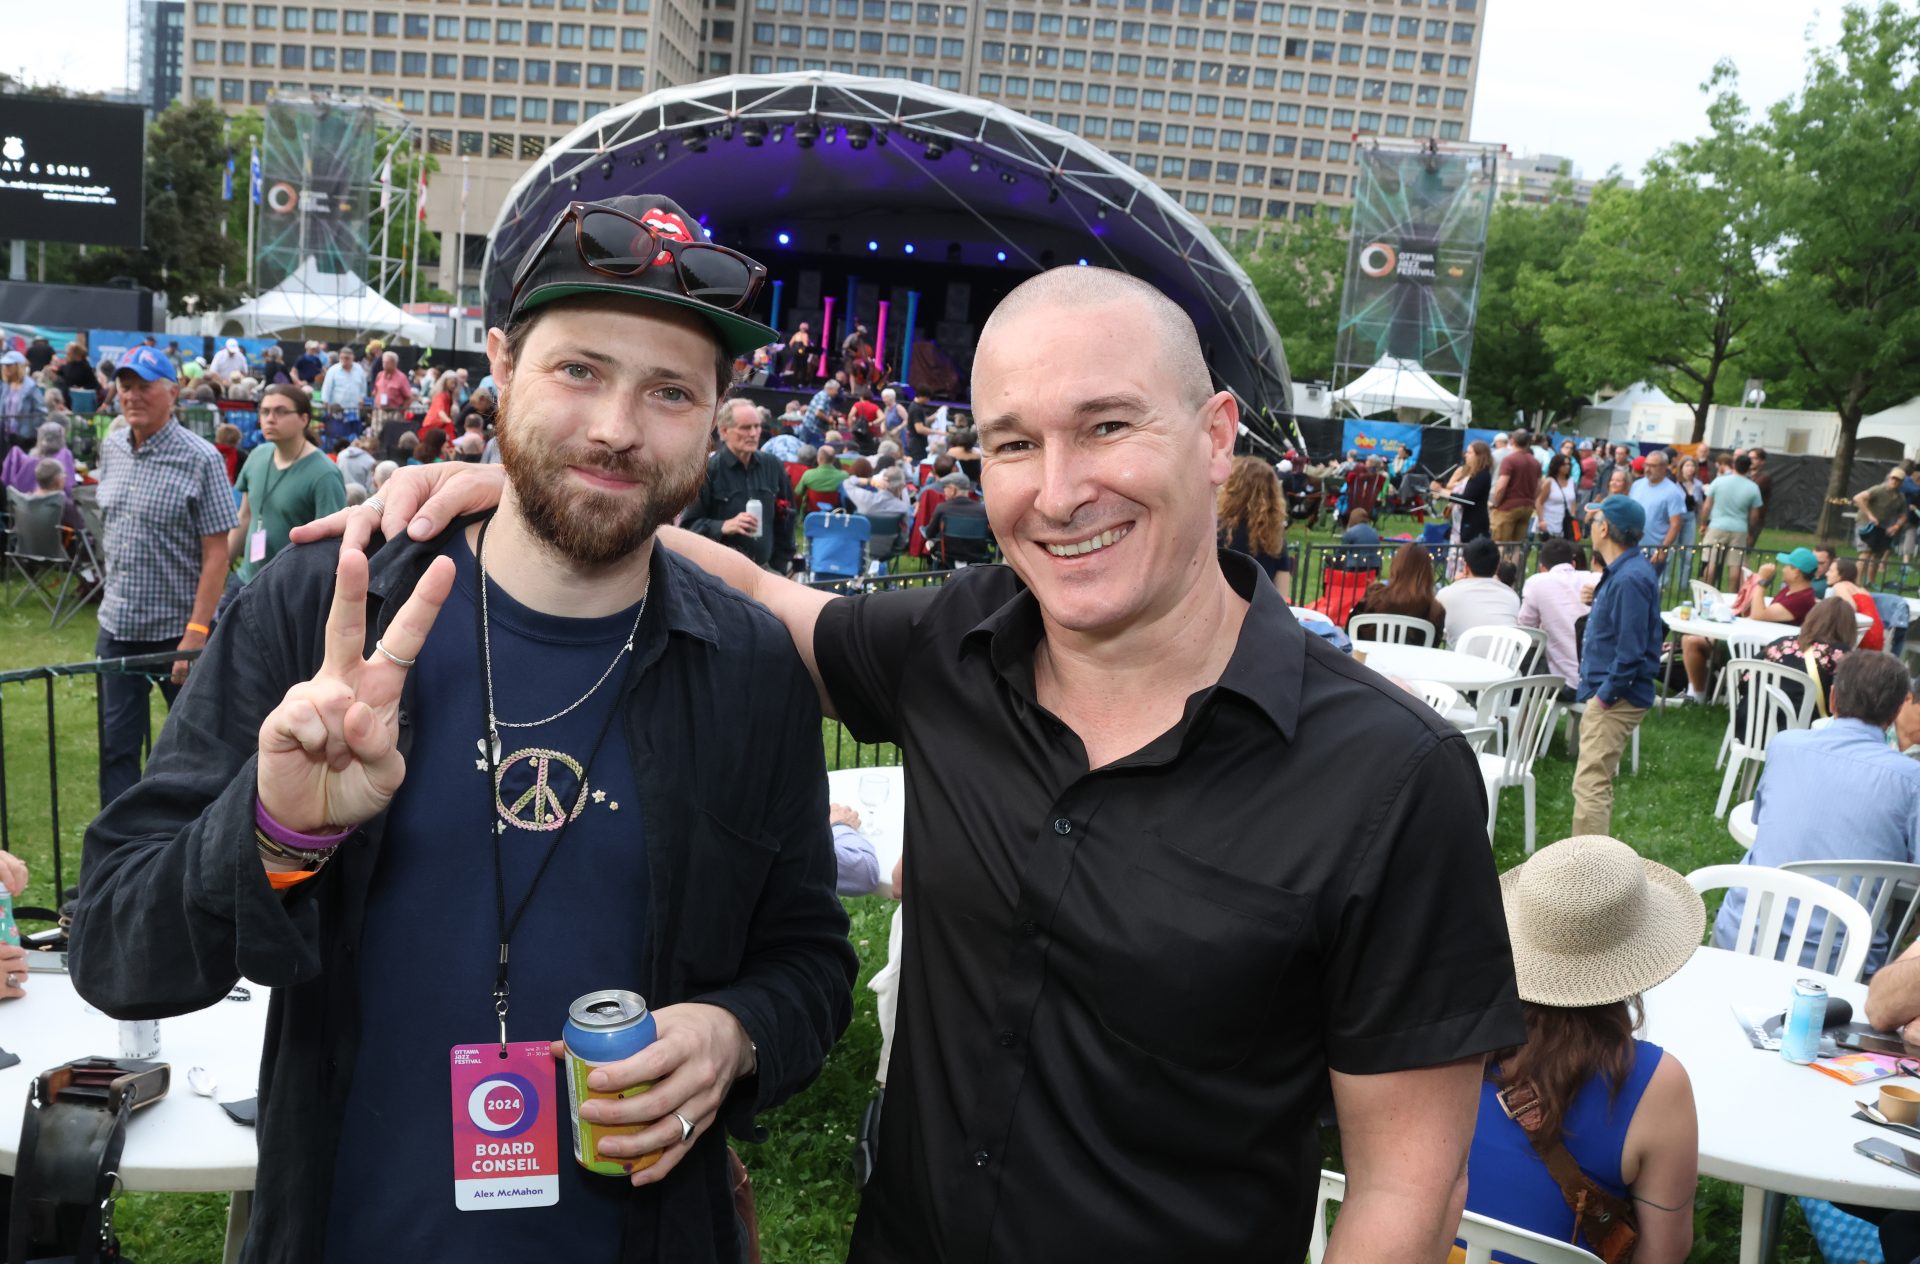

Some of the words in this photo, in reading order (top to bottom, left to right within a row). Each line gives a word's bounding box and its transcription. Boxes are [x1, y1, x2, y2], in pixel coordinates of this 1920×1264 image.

[0, 161, 22, 173] AY
[46, 163, 90, 178] SONS
[1399, 252, 1434, 262] OTTAWA
[1396, 268, 1436, 277] FESTIVAL
[487, 1099, 520, 1110] 2024
[475, 1141, 535, 1156] BOARD
[471, 1158, 540, 1173] CONSEIL
[473, 1190, 495, 1198] Alex
[497, 1187, 544, 1198] McMahon
